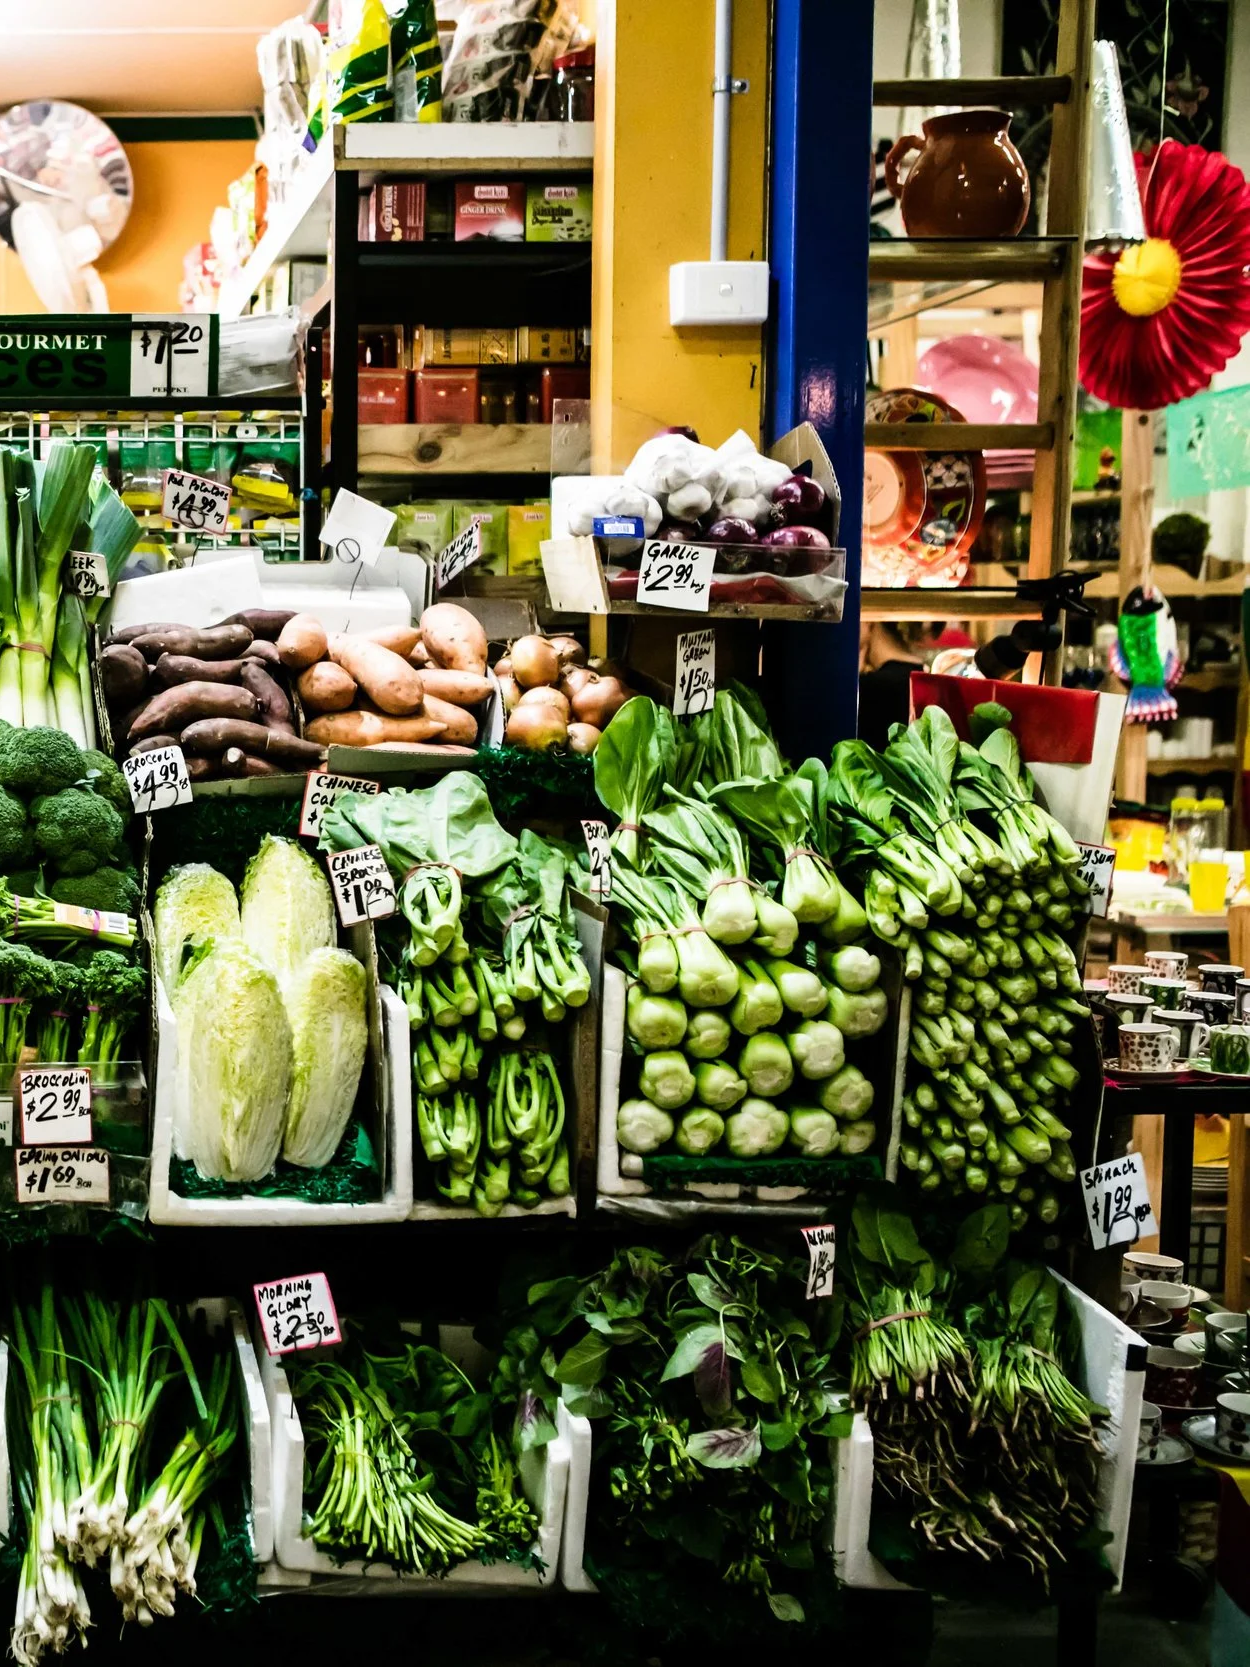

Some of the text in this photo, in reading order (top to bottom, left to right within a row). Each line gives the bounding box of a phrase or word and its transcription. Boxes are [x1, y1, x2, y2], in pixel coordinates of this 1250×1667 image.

[460, 204, 506, 215] GINGER DRINK
[71, 556, 96, 570] EEK
[316, 775, 377, 795] CHINESE
[258, 1279, 312, 1303] MORNING
[267, 1294, 312, 1319] GLORY
